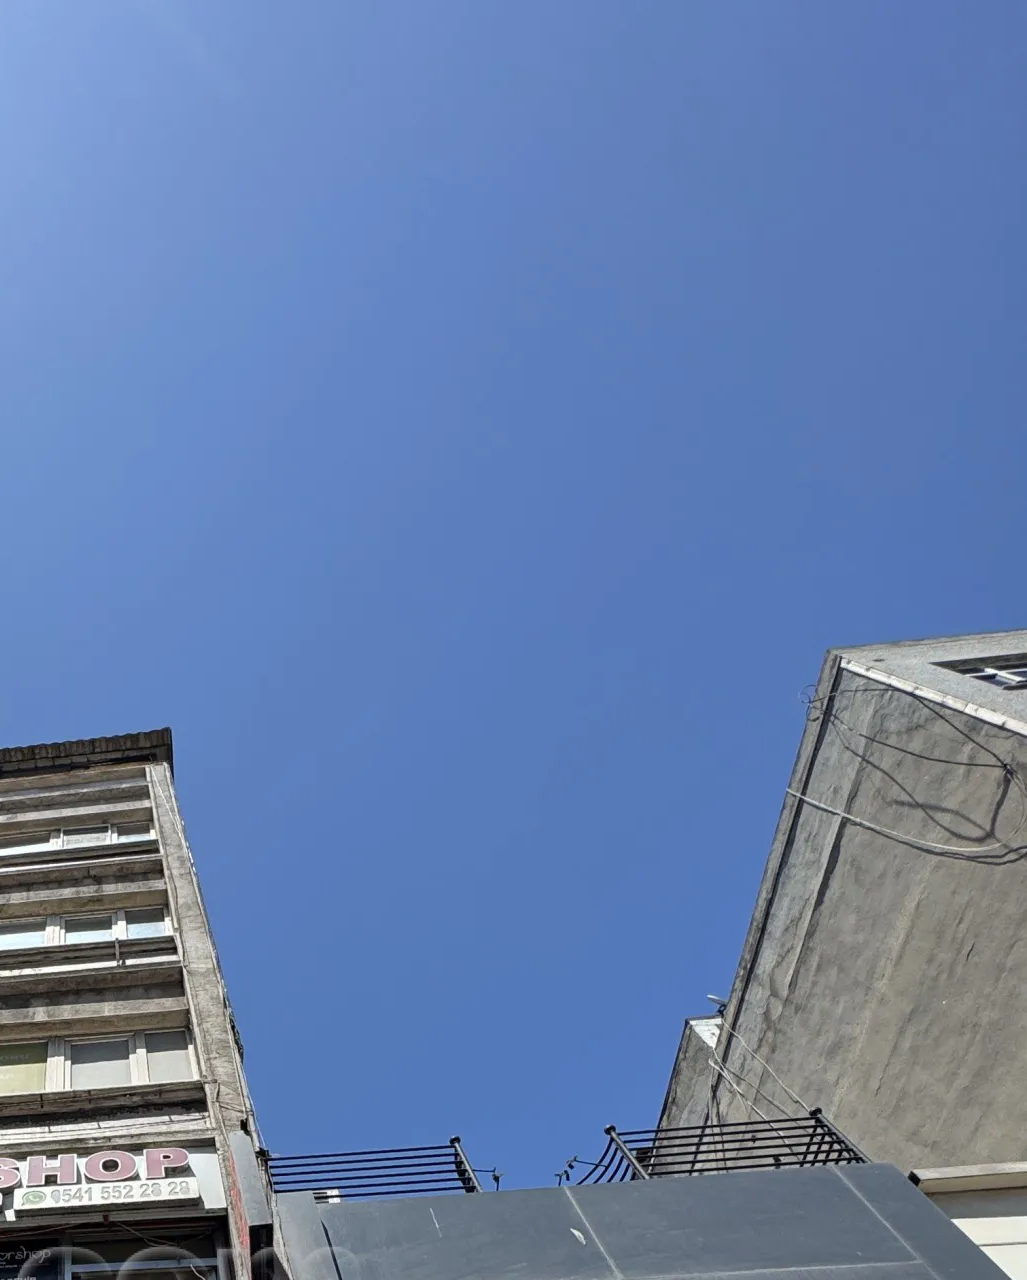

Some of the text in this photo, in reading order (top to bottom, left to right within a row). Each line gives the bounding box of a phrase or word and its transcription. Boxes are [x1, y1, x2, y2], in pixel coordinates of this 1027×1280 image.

[50, 1180, 191, 1204] 0541 552 28 28
